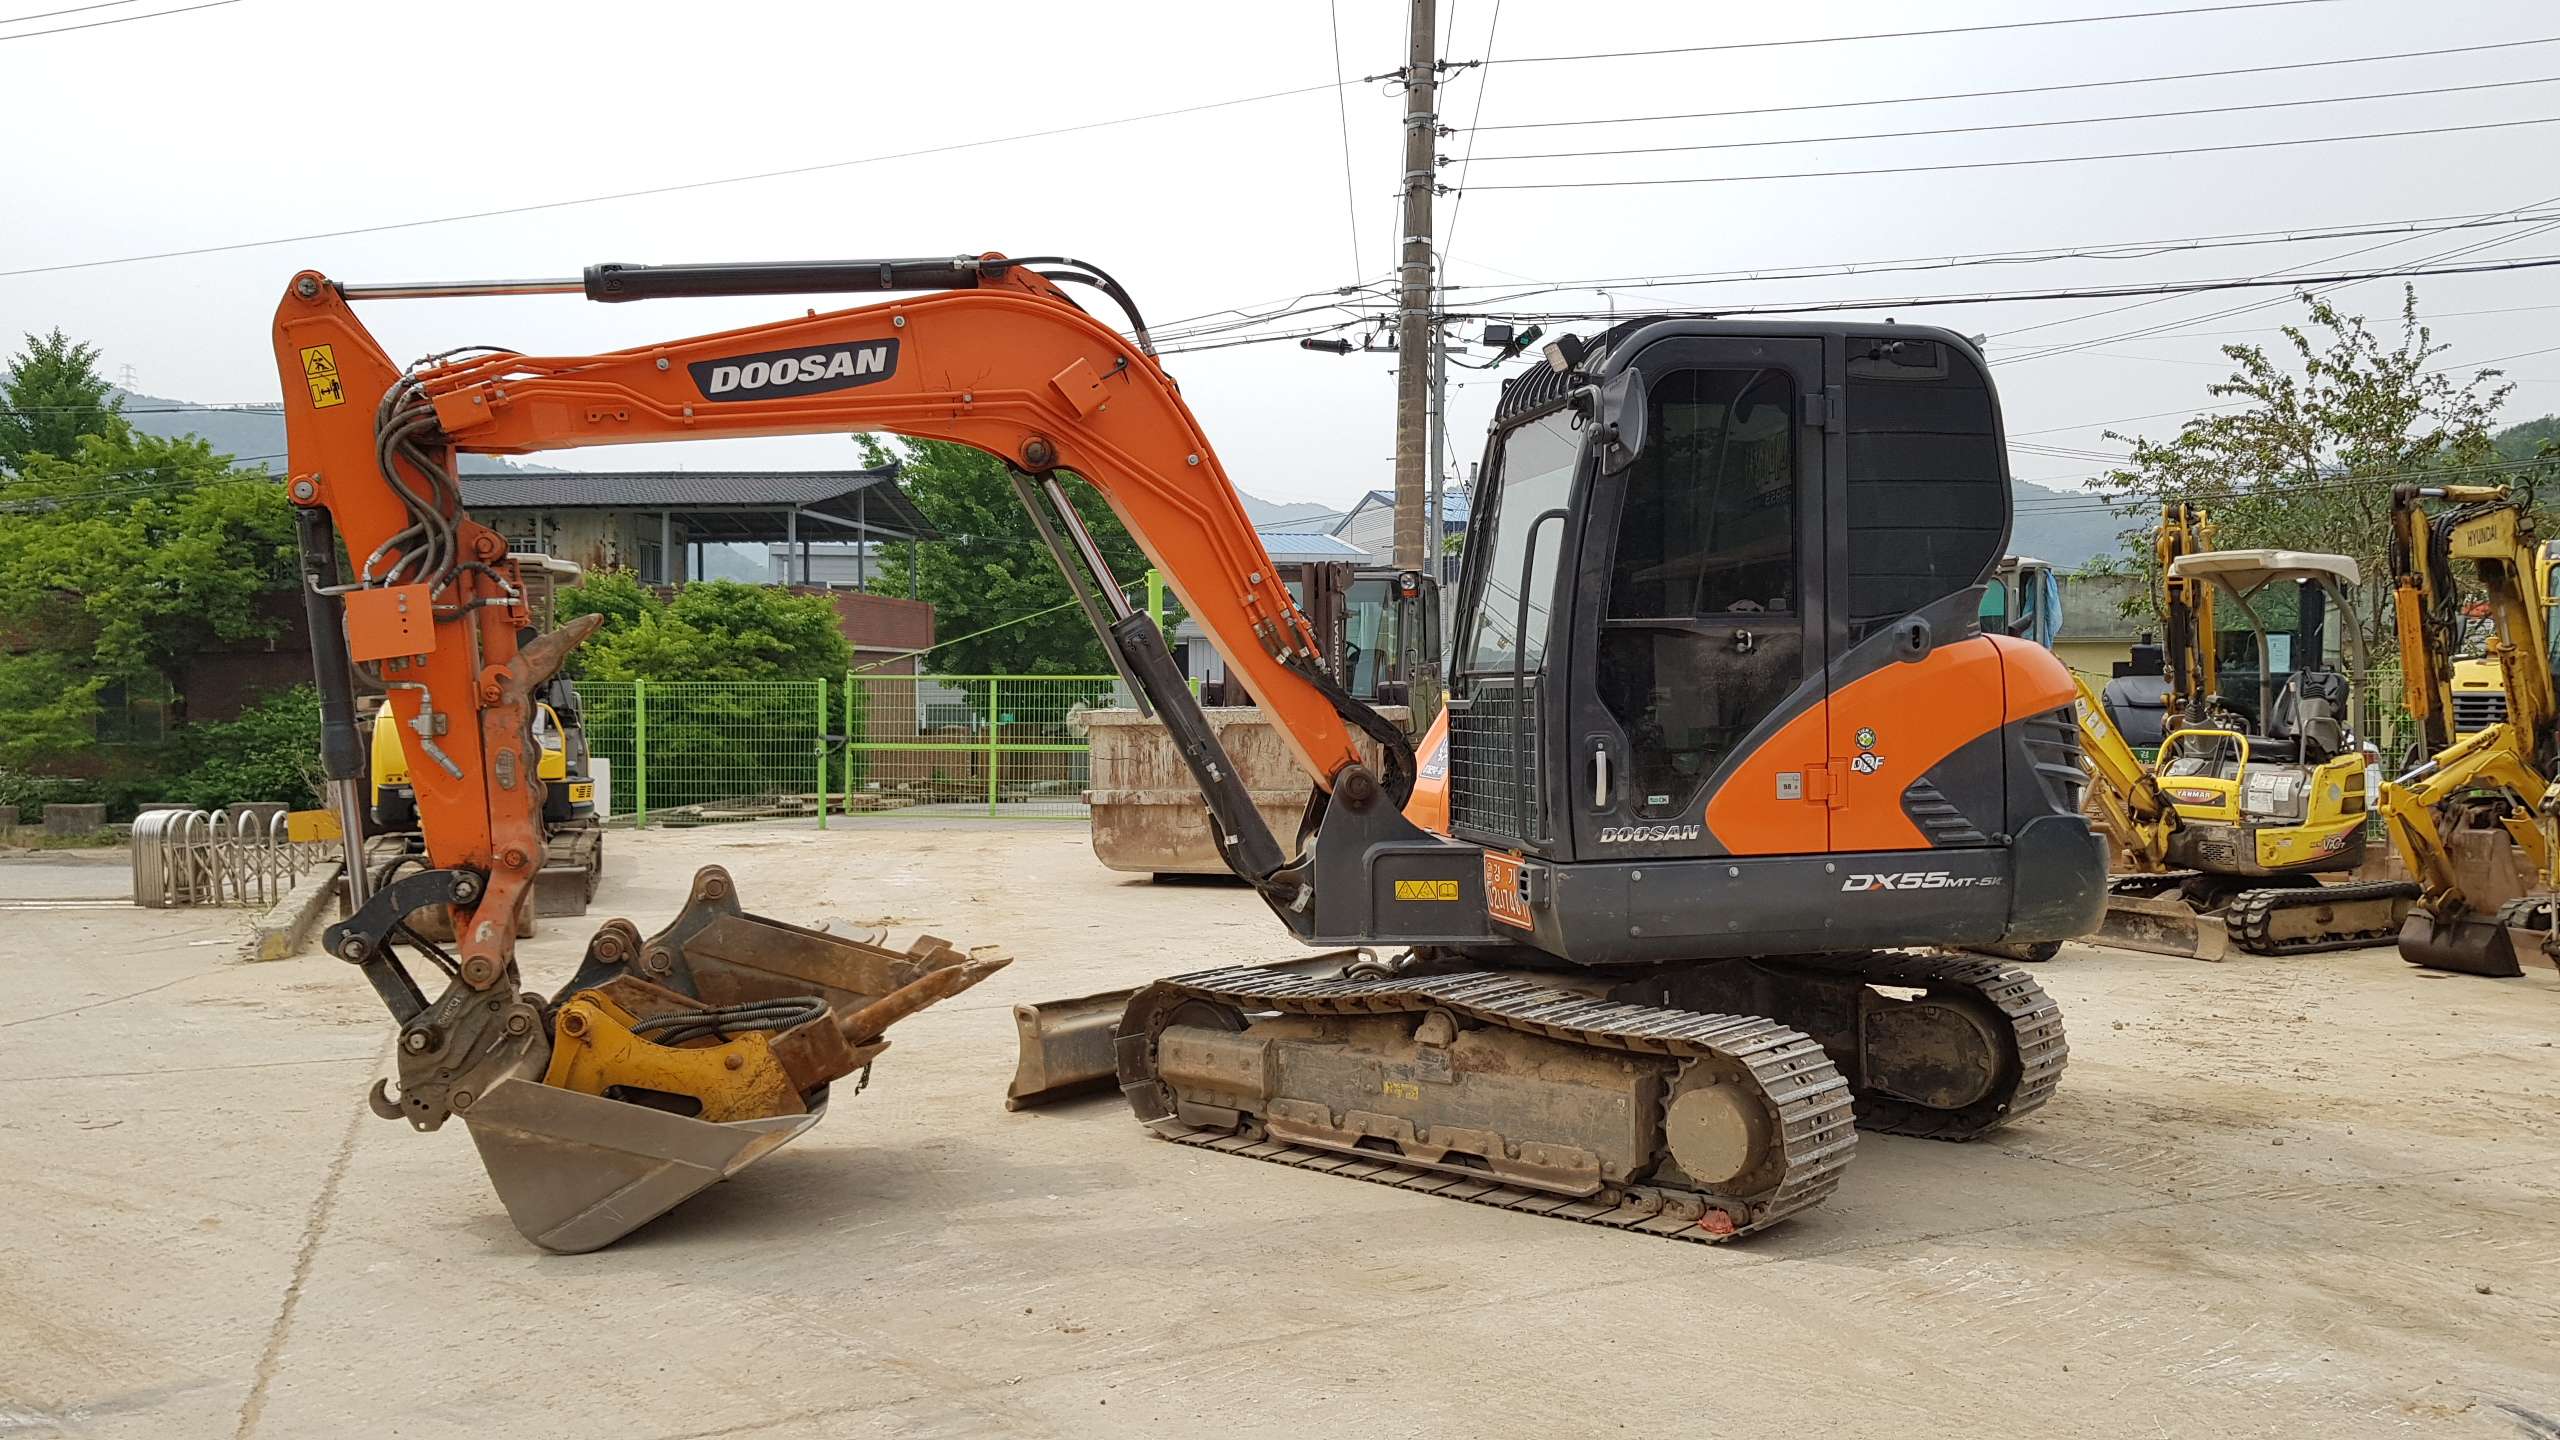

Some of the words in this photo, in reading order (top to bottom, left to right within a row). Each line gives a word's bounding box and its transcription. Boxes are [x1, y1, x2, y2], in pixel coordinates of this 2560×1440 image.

[709, 346, 887, 394] DOOSAN
[2467, 524, 2497, 547] HYUNDAI
[2177, 791, 2210, 799] YANMAR
[1599, 825, 1701, 843] DOOSAN
